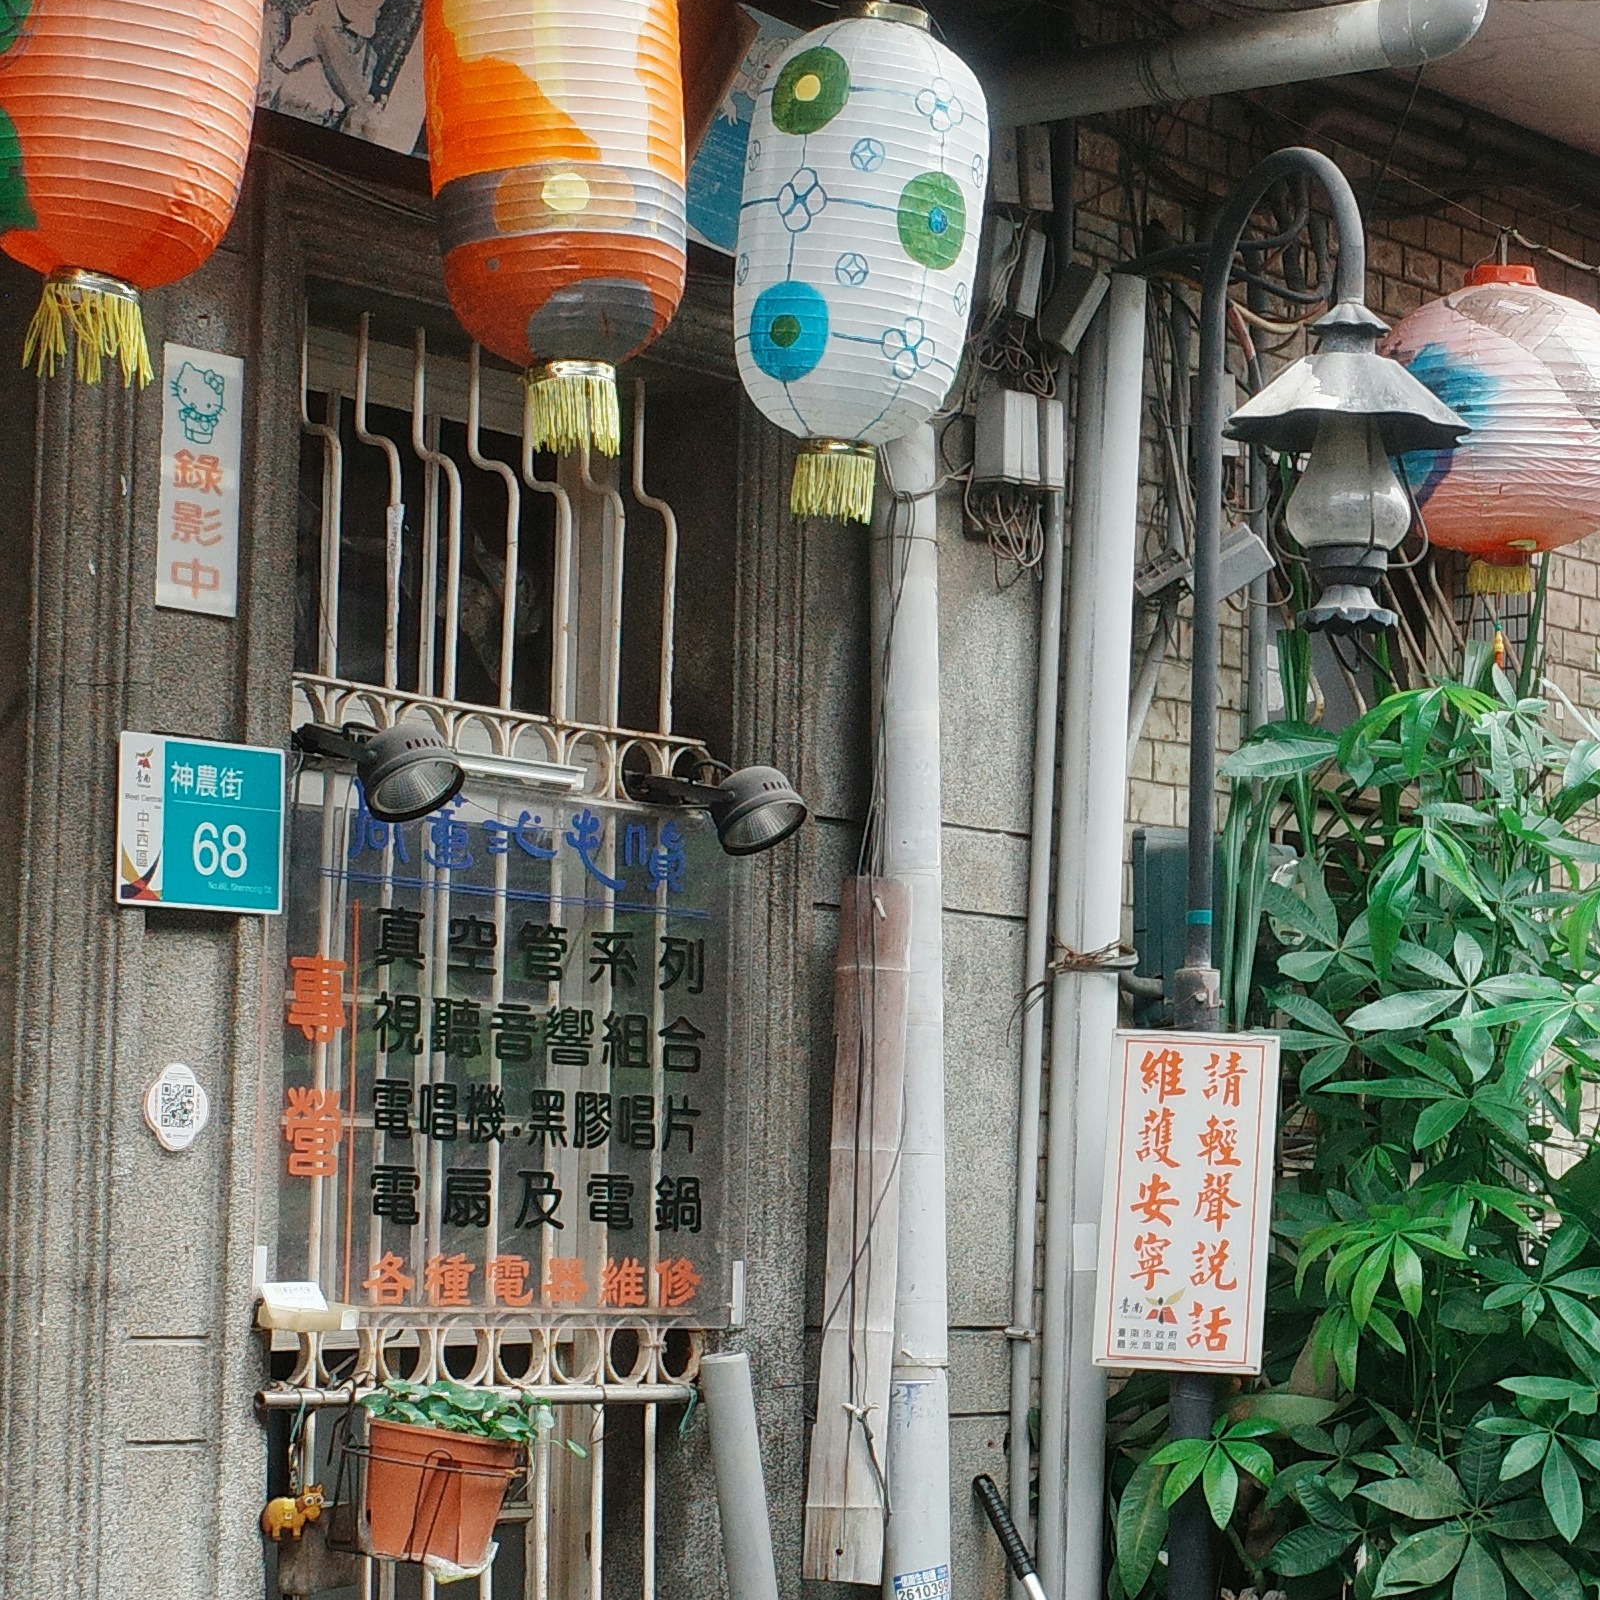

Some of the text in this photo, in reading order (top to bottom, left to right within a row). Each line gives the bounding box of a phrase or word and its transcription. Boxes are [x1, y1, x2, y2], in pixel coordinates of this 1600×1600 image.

[171, 448, 224, 599] 錄影中
[170, 760, 244, 801] 神農街
[192, 821, 248, 878] 68
[375, 907, 705, 993] 真空管系列
[288, 953, 347, 1177] 專營
[373, 991, 706, 1073] 視聽音響組合
[370, 1164, 702, 1234] 電扇及電鍋
[362, 1250, 701, 1308] 各種電器維修
